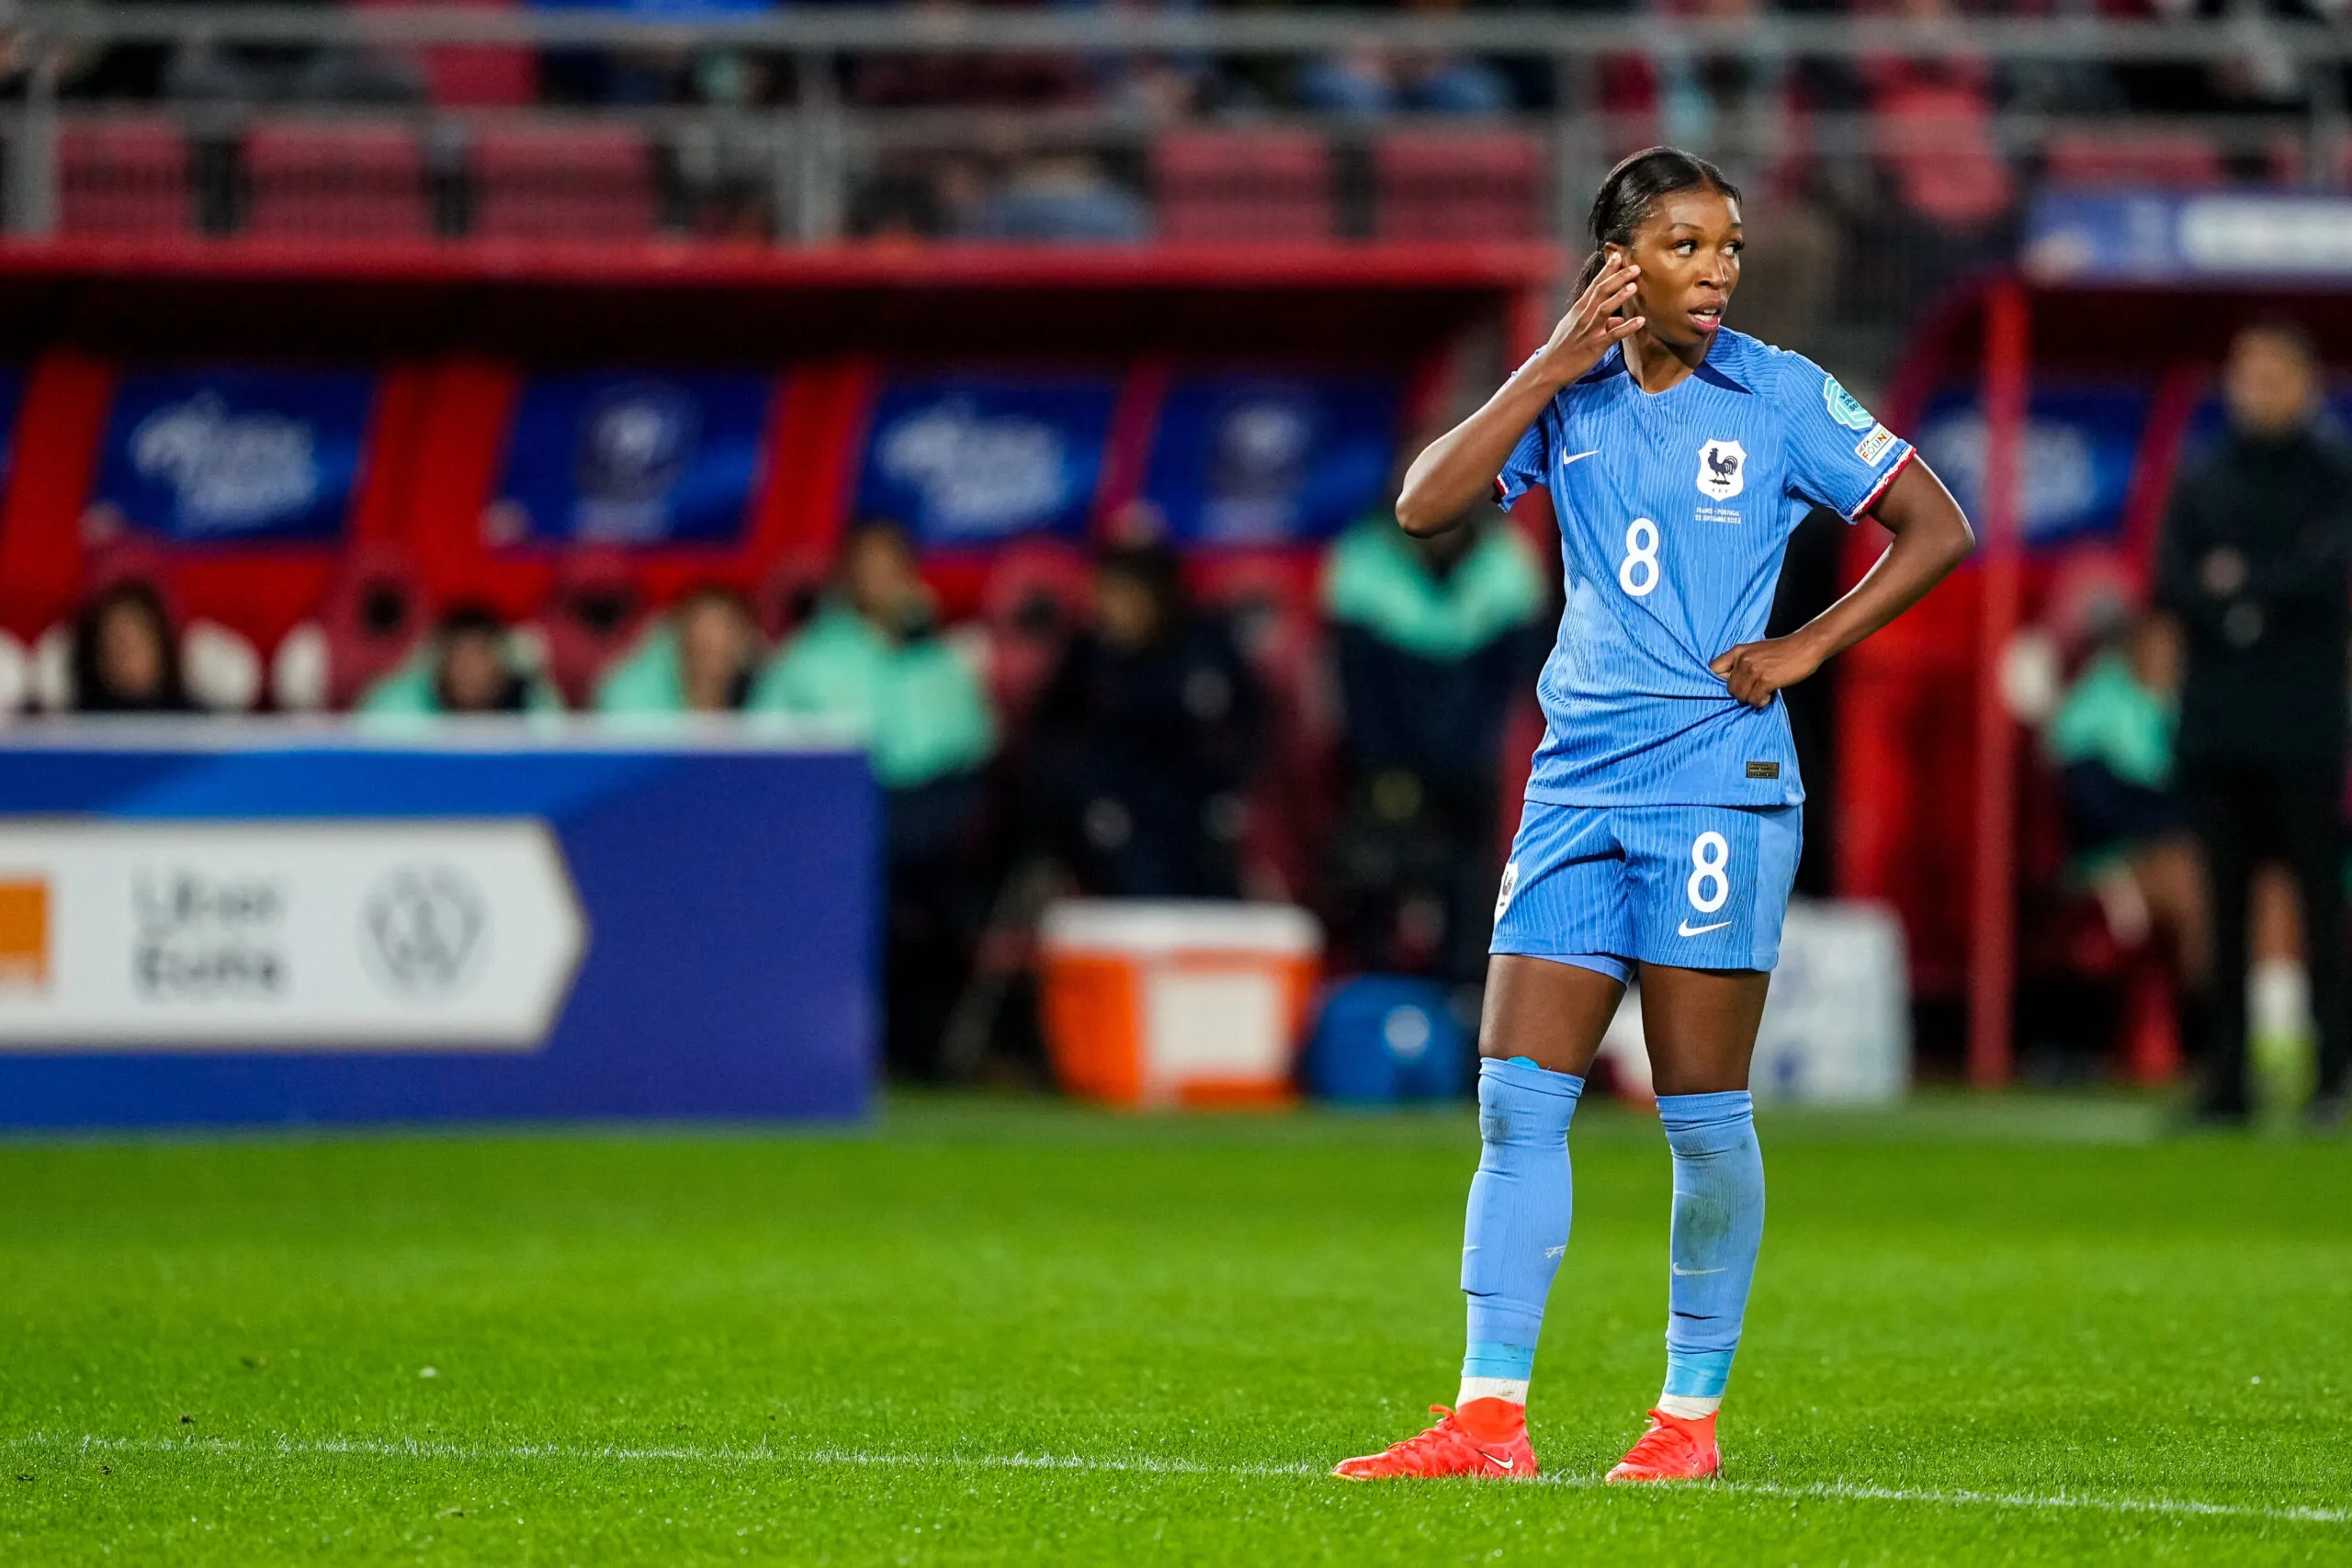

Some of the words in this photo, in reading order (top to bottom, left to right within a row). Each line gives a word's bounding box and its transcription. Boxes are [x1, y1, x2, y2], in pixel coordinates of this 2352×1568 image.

[1861, 433, 1890, 459] FOUN
[1620, 517, 1659, 596] 8
[1687, 831, 1729, 913] 8
